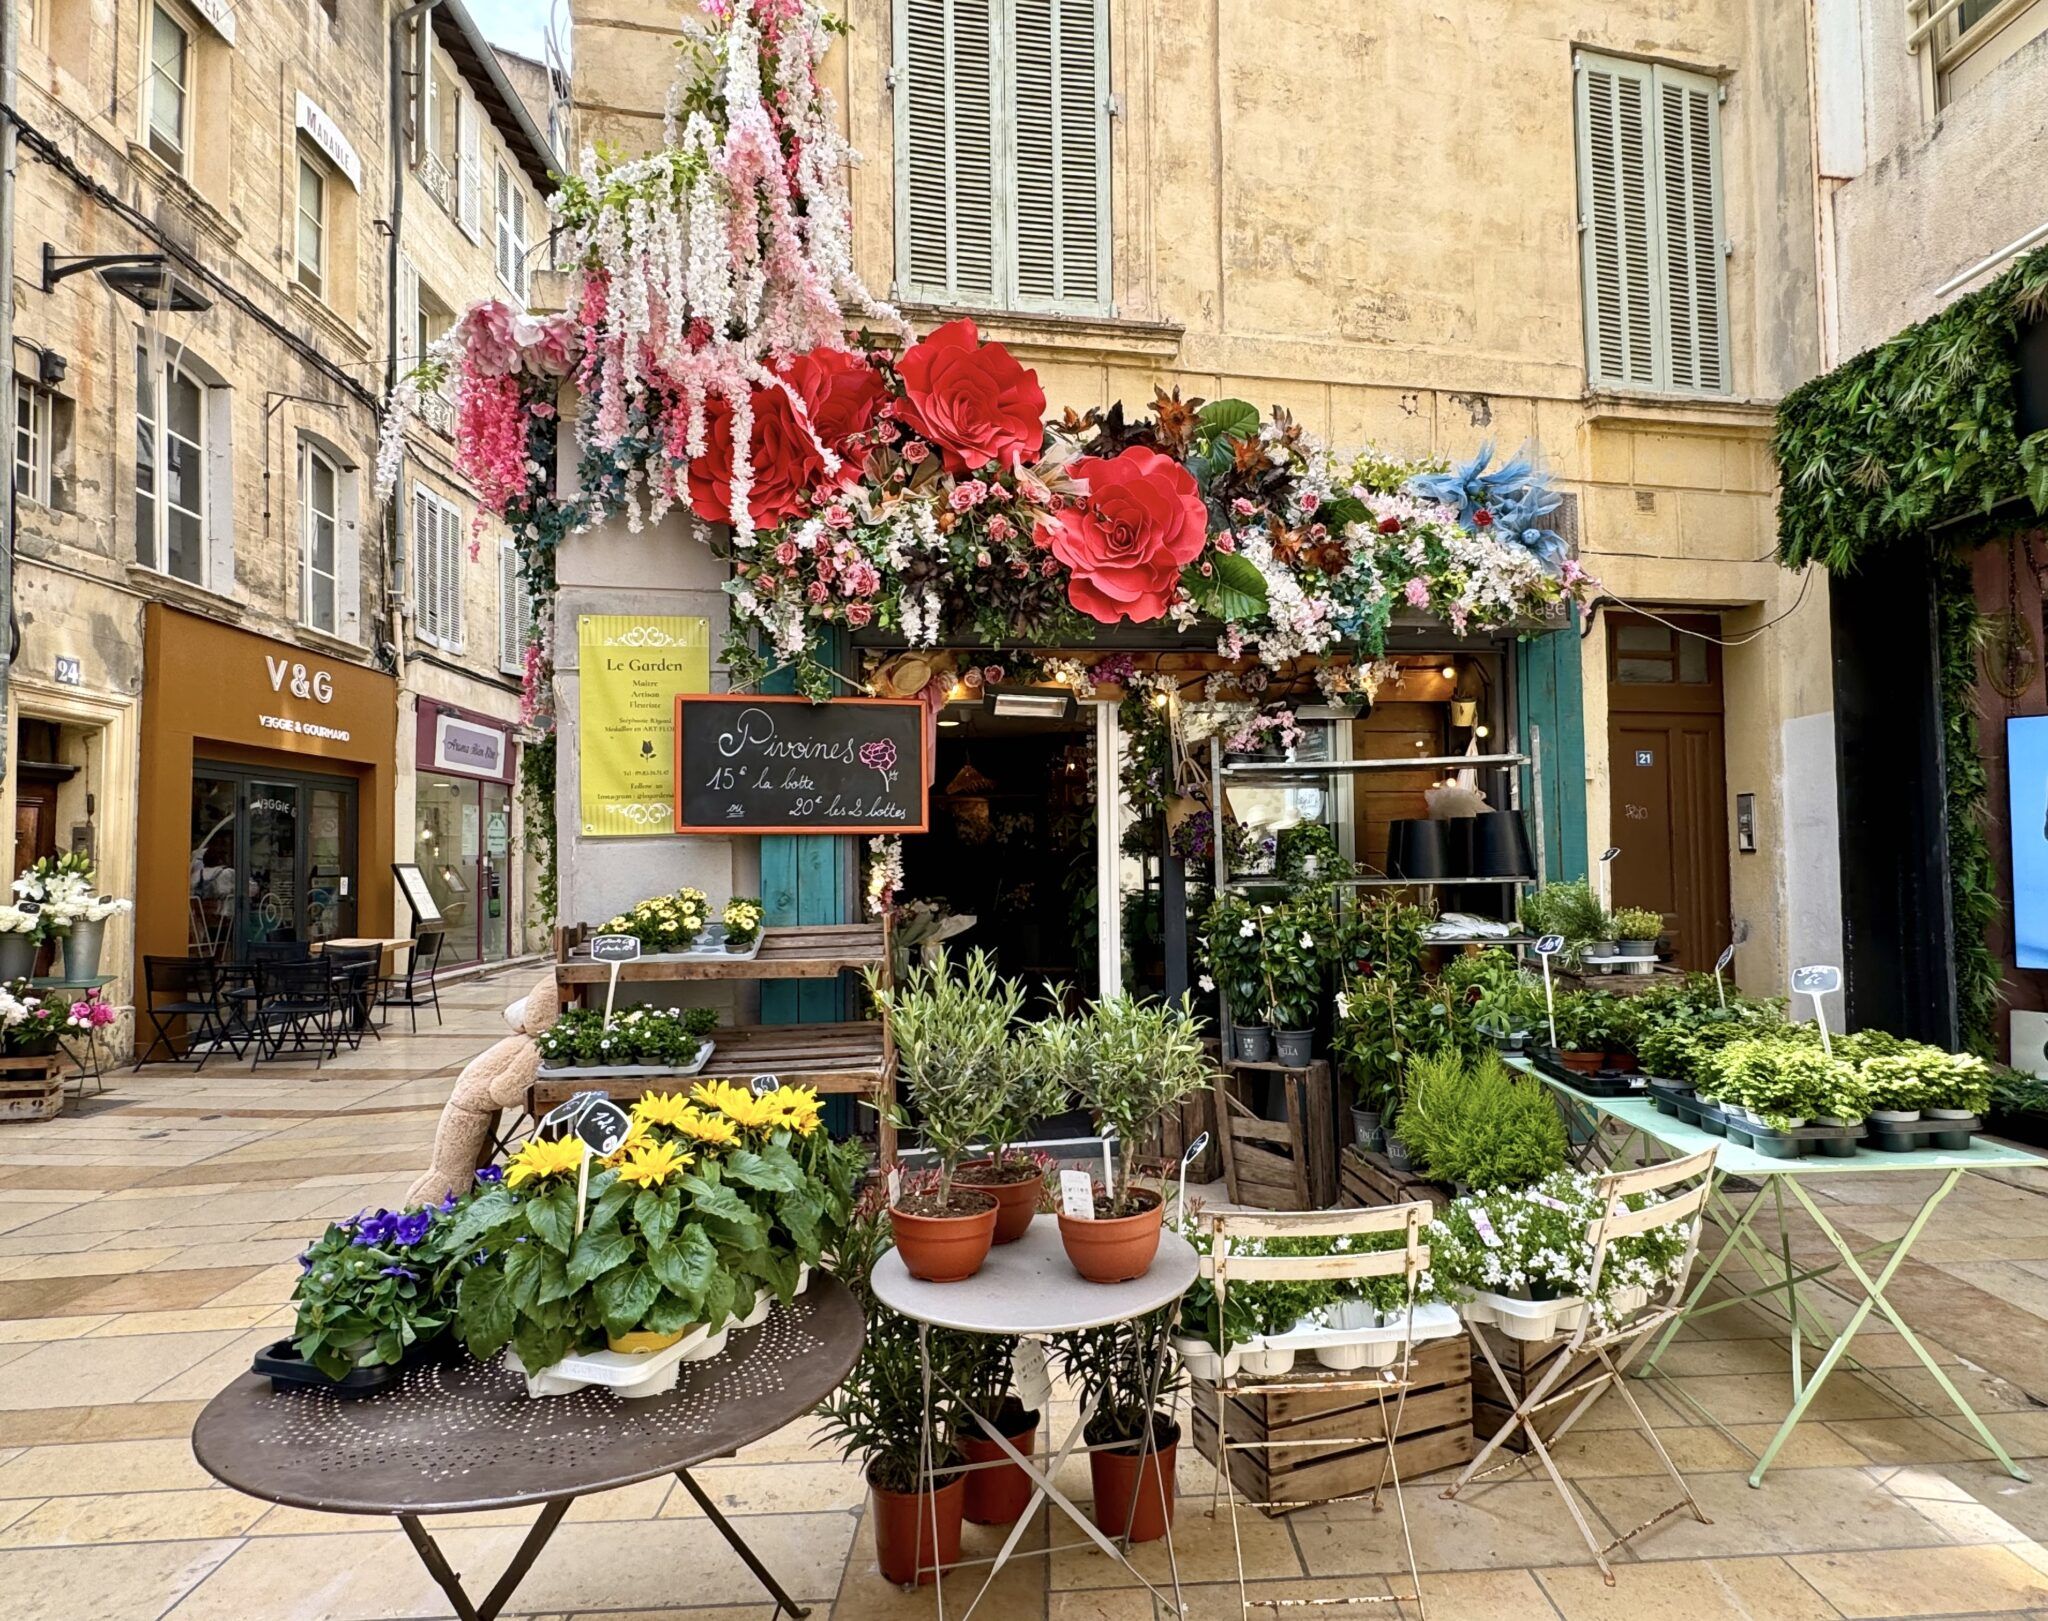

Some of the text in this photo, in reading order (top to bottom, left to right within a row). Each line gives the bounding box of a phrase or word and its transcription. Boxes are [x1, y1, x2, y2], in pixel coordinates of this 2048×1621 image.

[306, 105, 350, 171] MADAULE
[1516, 600, 1567, 619] otage
[58, 660, 78, 684] 24
[607, 657, 683, 672] Le Garden
[265, 655, 333, 704] V&G
[629, 700, 662, 709] Fleuriste
[718, 707, 855, 764] Pivoines
[1639, 753, 1651, 764] 21
[752, 767, 773, 789] la
[780, 767, 815, 790] botte
[726, 803, 745, 814] ou
[824, 795, 846, 816] les
[848, 799, 862, 816] 2
[865, 796, 907, 819] bottes
